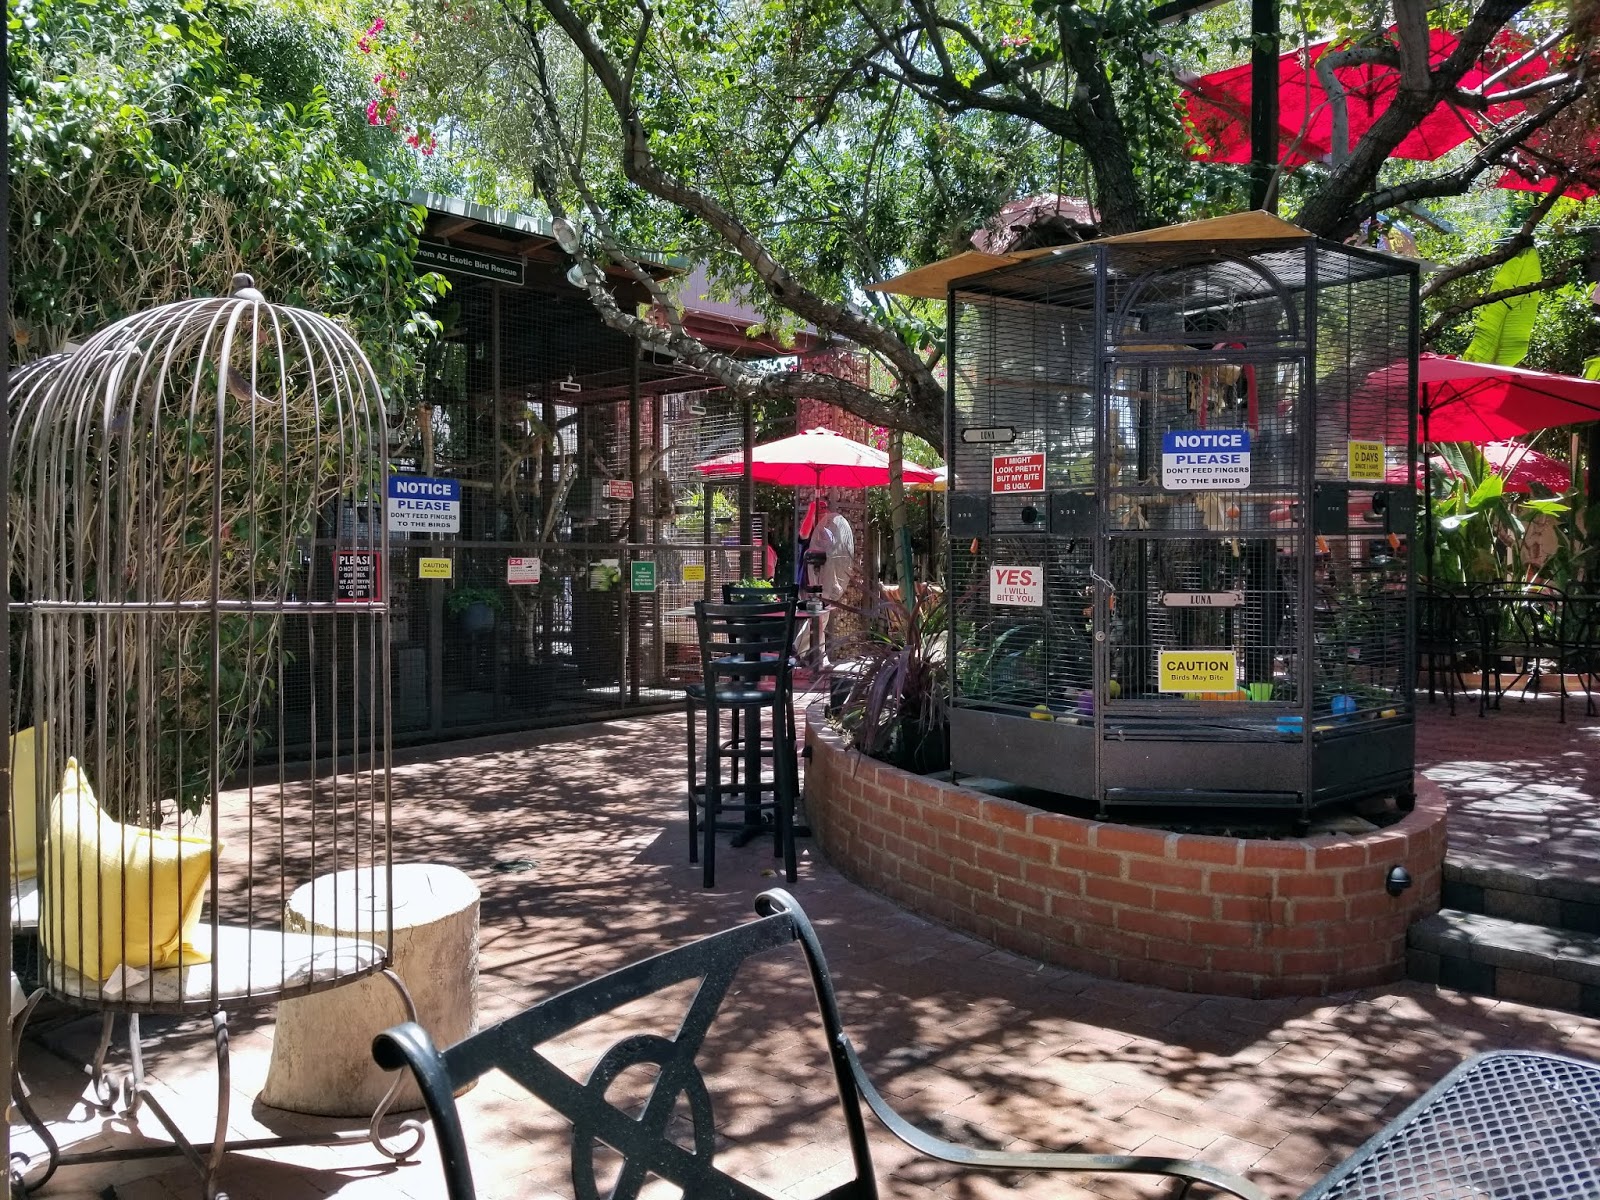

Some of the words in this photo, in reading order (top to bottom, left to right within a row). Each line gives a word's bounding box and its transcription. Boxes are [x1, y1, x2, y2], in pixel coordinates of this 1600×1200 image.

[417, 248, 435, 258] rom
[437, 252, 448, 261] AZ
[449, 254, 473, 267] Exotic
[474, 260, 490, 271] Bird
[491, 264, 517, 277] Rescue
[980, 430, 995, 440] LUNA
[1175, 435, 1242, 448] NOTICE
[1004, 457, 1008, 465] I
[1008, 456, 1032, 465] MIGHT
[1176, 455, 1241, 464] PLEASE
[1361, 452, 1379, 463] DAYS
[995, 466, 1013, 474] LOOK
[1014, 464, 1042, 473] PRETTY
[996, 475, 1010, 483] BUT
[1011, 474, 1023, 482] MY
[1023, 473, 1040, 481] BITE
[396, 481, 452, 497] NOTICE
[1012, 482, 1031, 490] UGLY.
[397, 500, 451, 511] PLEASE
[995, 569, 1037, 586] YES.
[1004, 587, 1007, 595] I
[1008, 587, 1028, 595] WILL
[996, 594, 1015, 602] BITE
[1016, 595, 1036, 603] YOU.
[1189, 595, 1212, 605] LUNA
[1166, 661, 1229, 672] CAUTION
[1192, 674, 1207, 682] May
